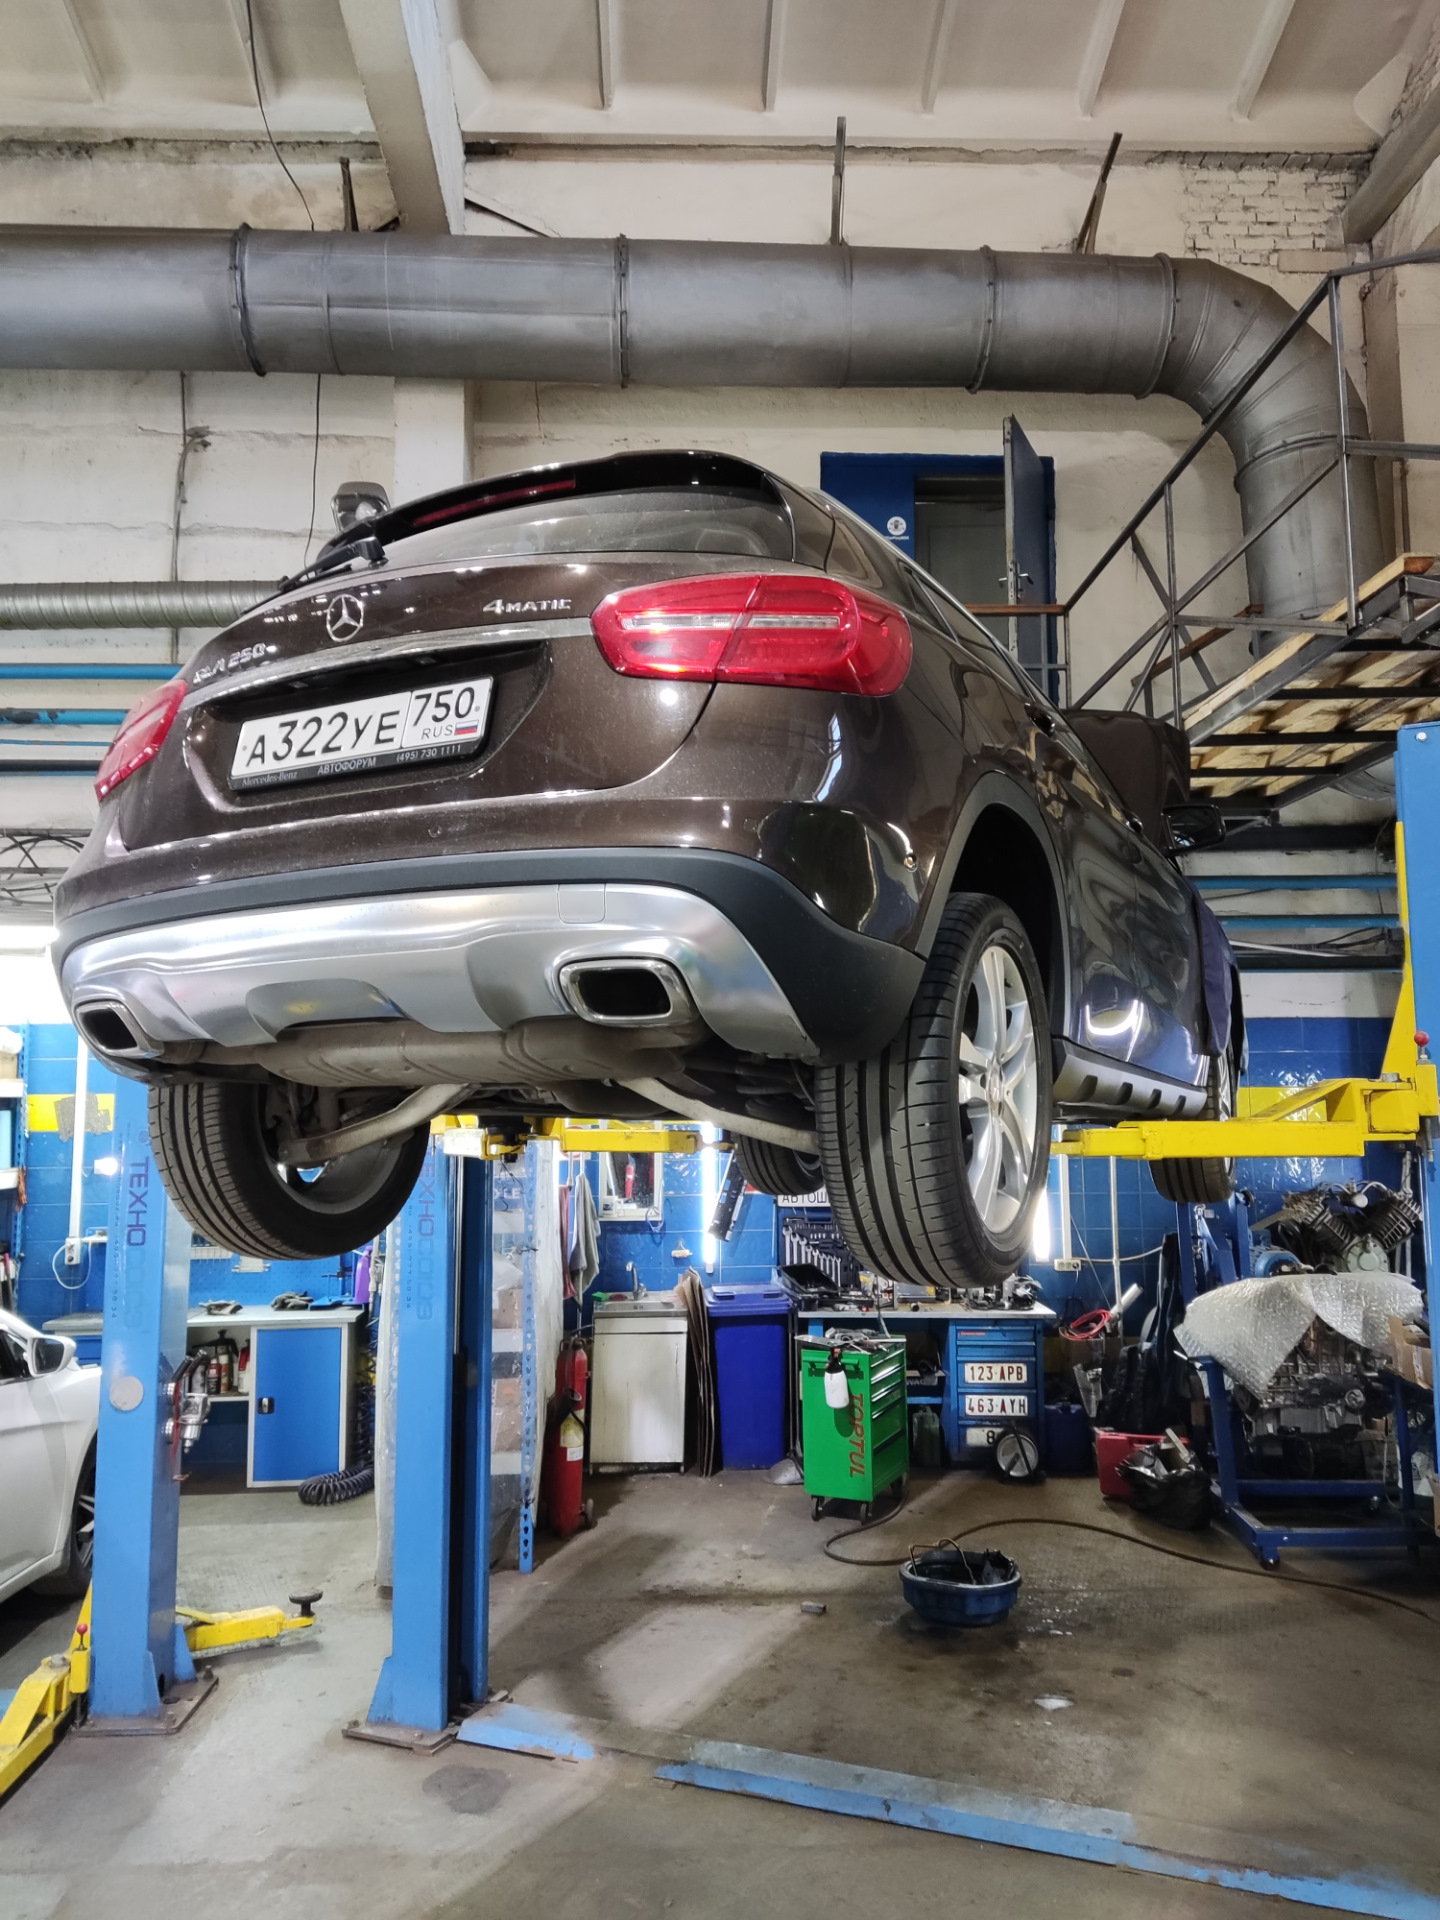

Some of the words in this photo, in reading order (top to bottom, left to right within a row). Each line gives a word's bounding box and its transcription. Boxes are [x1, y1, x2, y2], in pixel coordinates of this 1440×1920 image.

[482, 598, 572, 614] 4MATIC
[227, 642, 267, 668] 250
[412, 686, 475, 727] 750
[421, 723, 454, 741] RUS
[396, 750, 419, 763] (495)
[420, 747, 438, 759] 730
[441, 744, 461, 756] 1111
[317, 756, 377, 776] АВТОФОРУМ
[242, 771, 299, 787] Mercedes-Benz
[849, 1393, 866, 1478] TOPTUL
